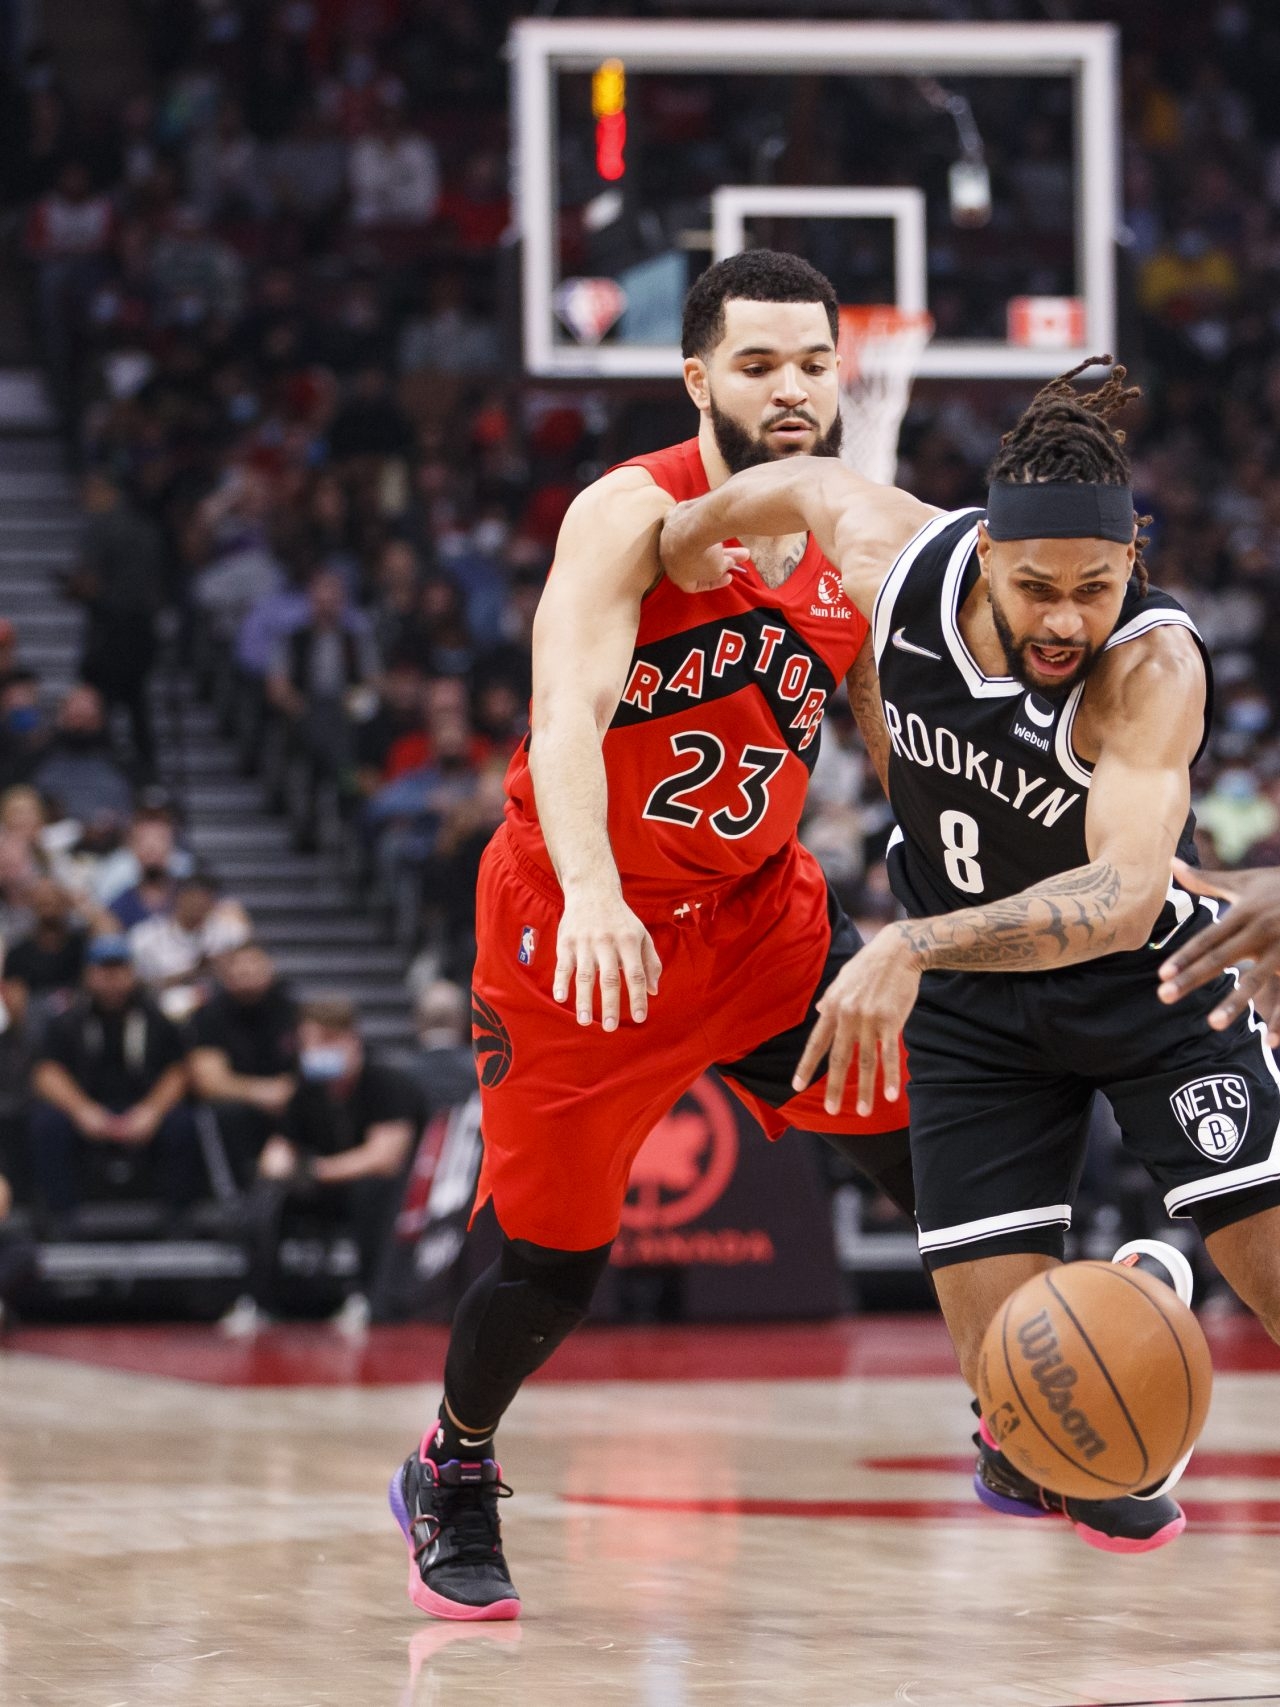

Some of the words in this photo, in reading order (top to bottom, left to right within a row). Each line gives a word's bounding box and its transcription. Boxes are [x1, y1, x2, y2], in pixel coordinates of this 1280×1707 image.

[810, 604, 828, 618] Sun
[831, 606, 852, 620] Life
[884, 699, 1081, 828] ROOKLYN
[1013, 723, 1051, 752] Webull
[641, 730, 789, 840] 23
[939, 809, 985, 894] 8
[1174, 1078, 1247, 1127] NETS
[1208, 1120, 1228, 1151] B
[1017, 1307, 1107, 1461] Wilson
